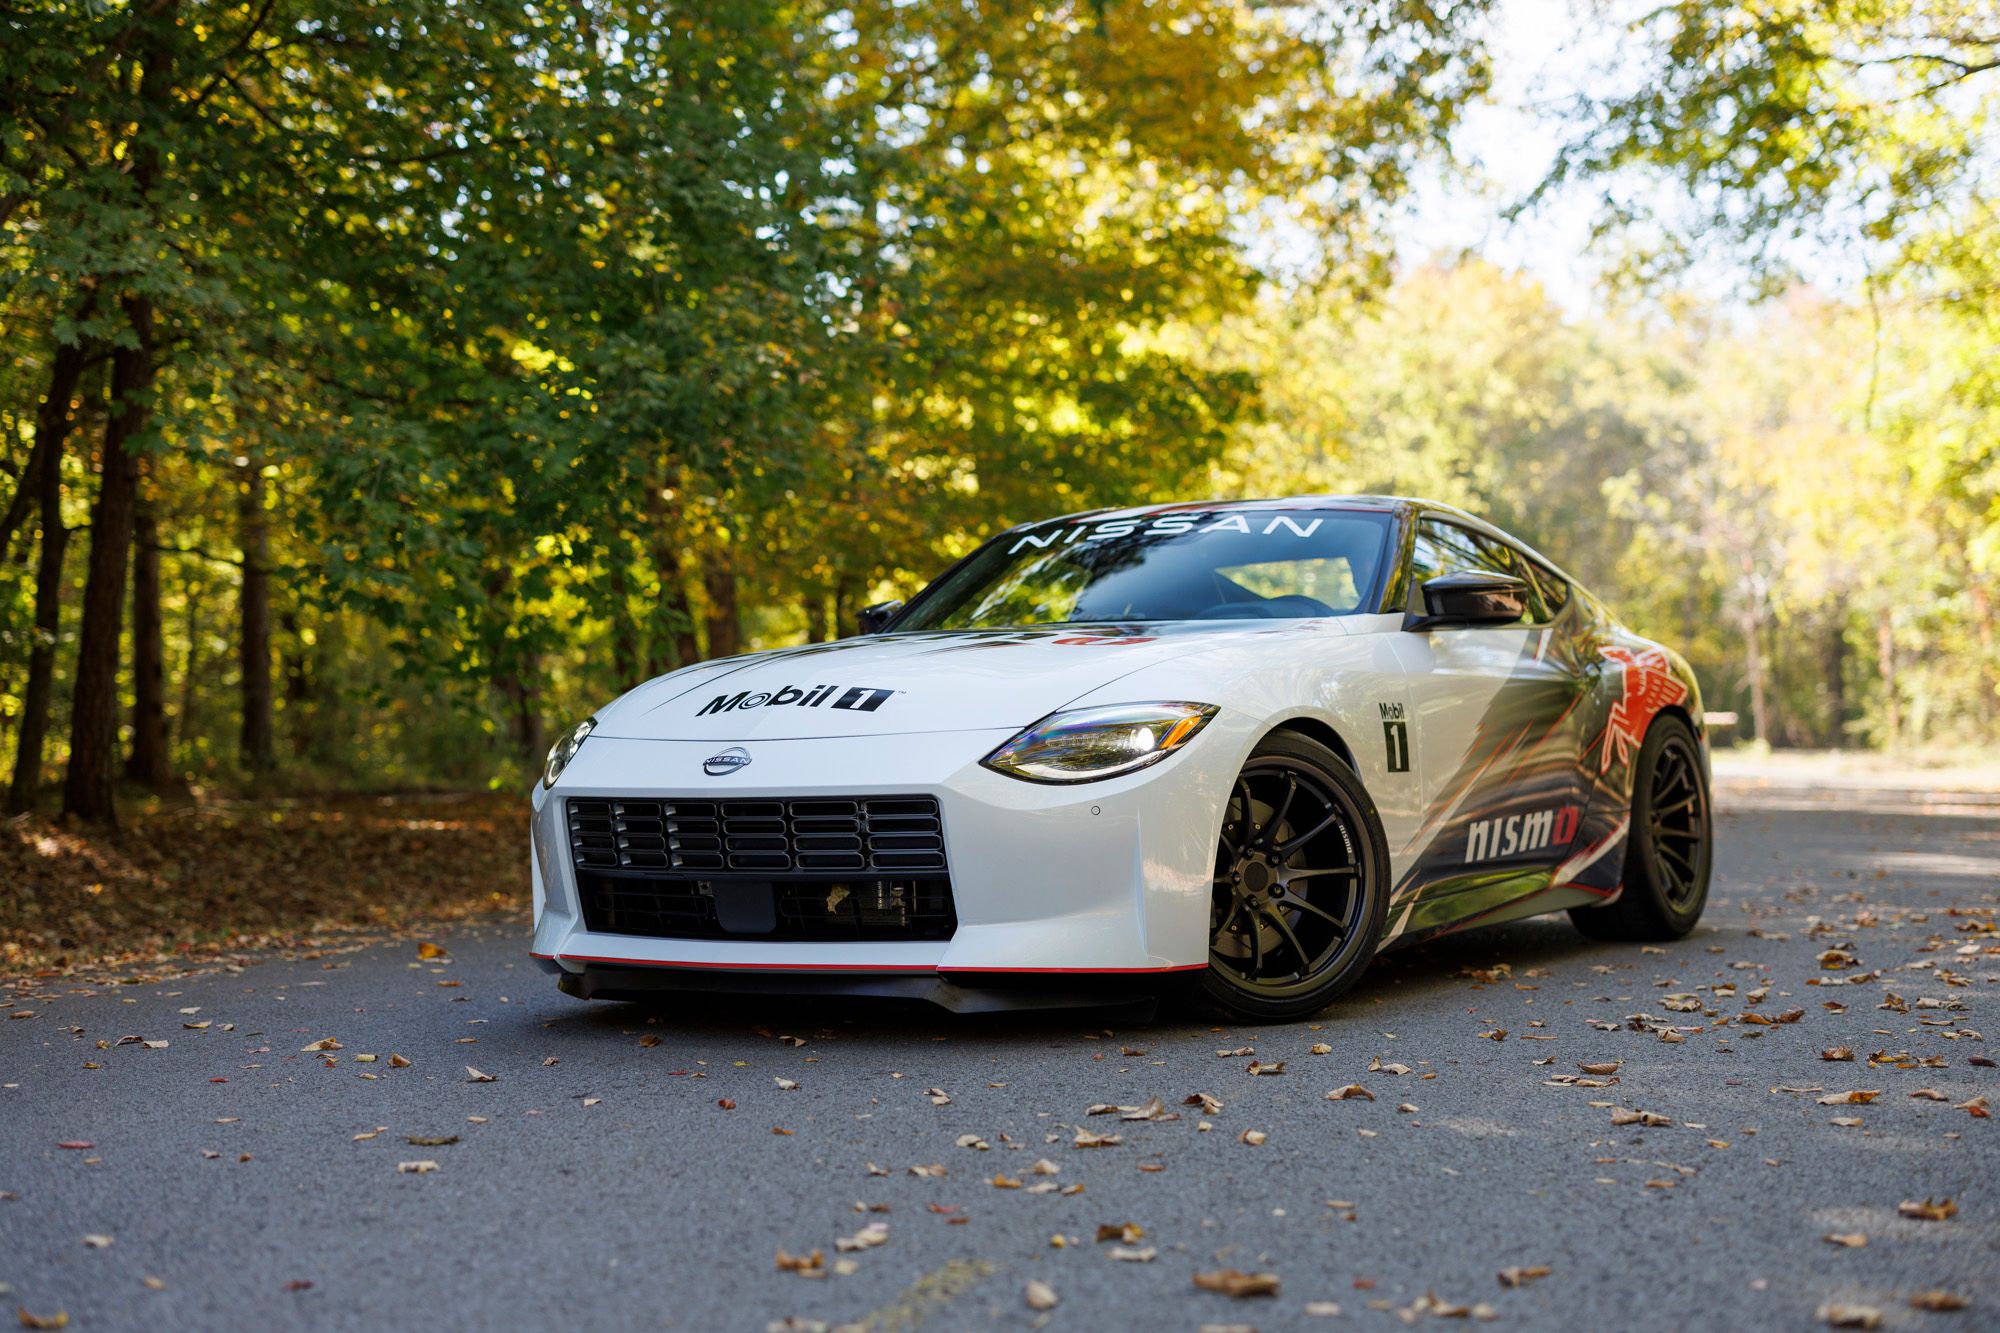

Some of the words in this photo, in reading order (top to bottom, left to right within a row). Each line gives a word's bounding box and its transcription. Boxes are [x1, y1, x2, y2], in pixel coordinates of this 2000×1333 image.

[1008, 515, 1324, 555] NISSAN
[695, 684, 839, 717] Mobil
[1379, 702, 1405, 720] Mobil
[706, 756, 749, 765] NISSAN
